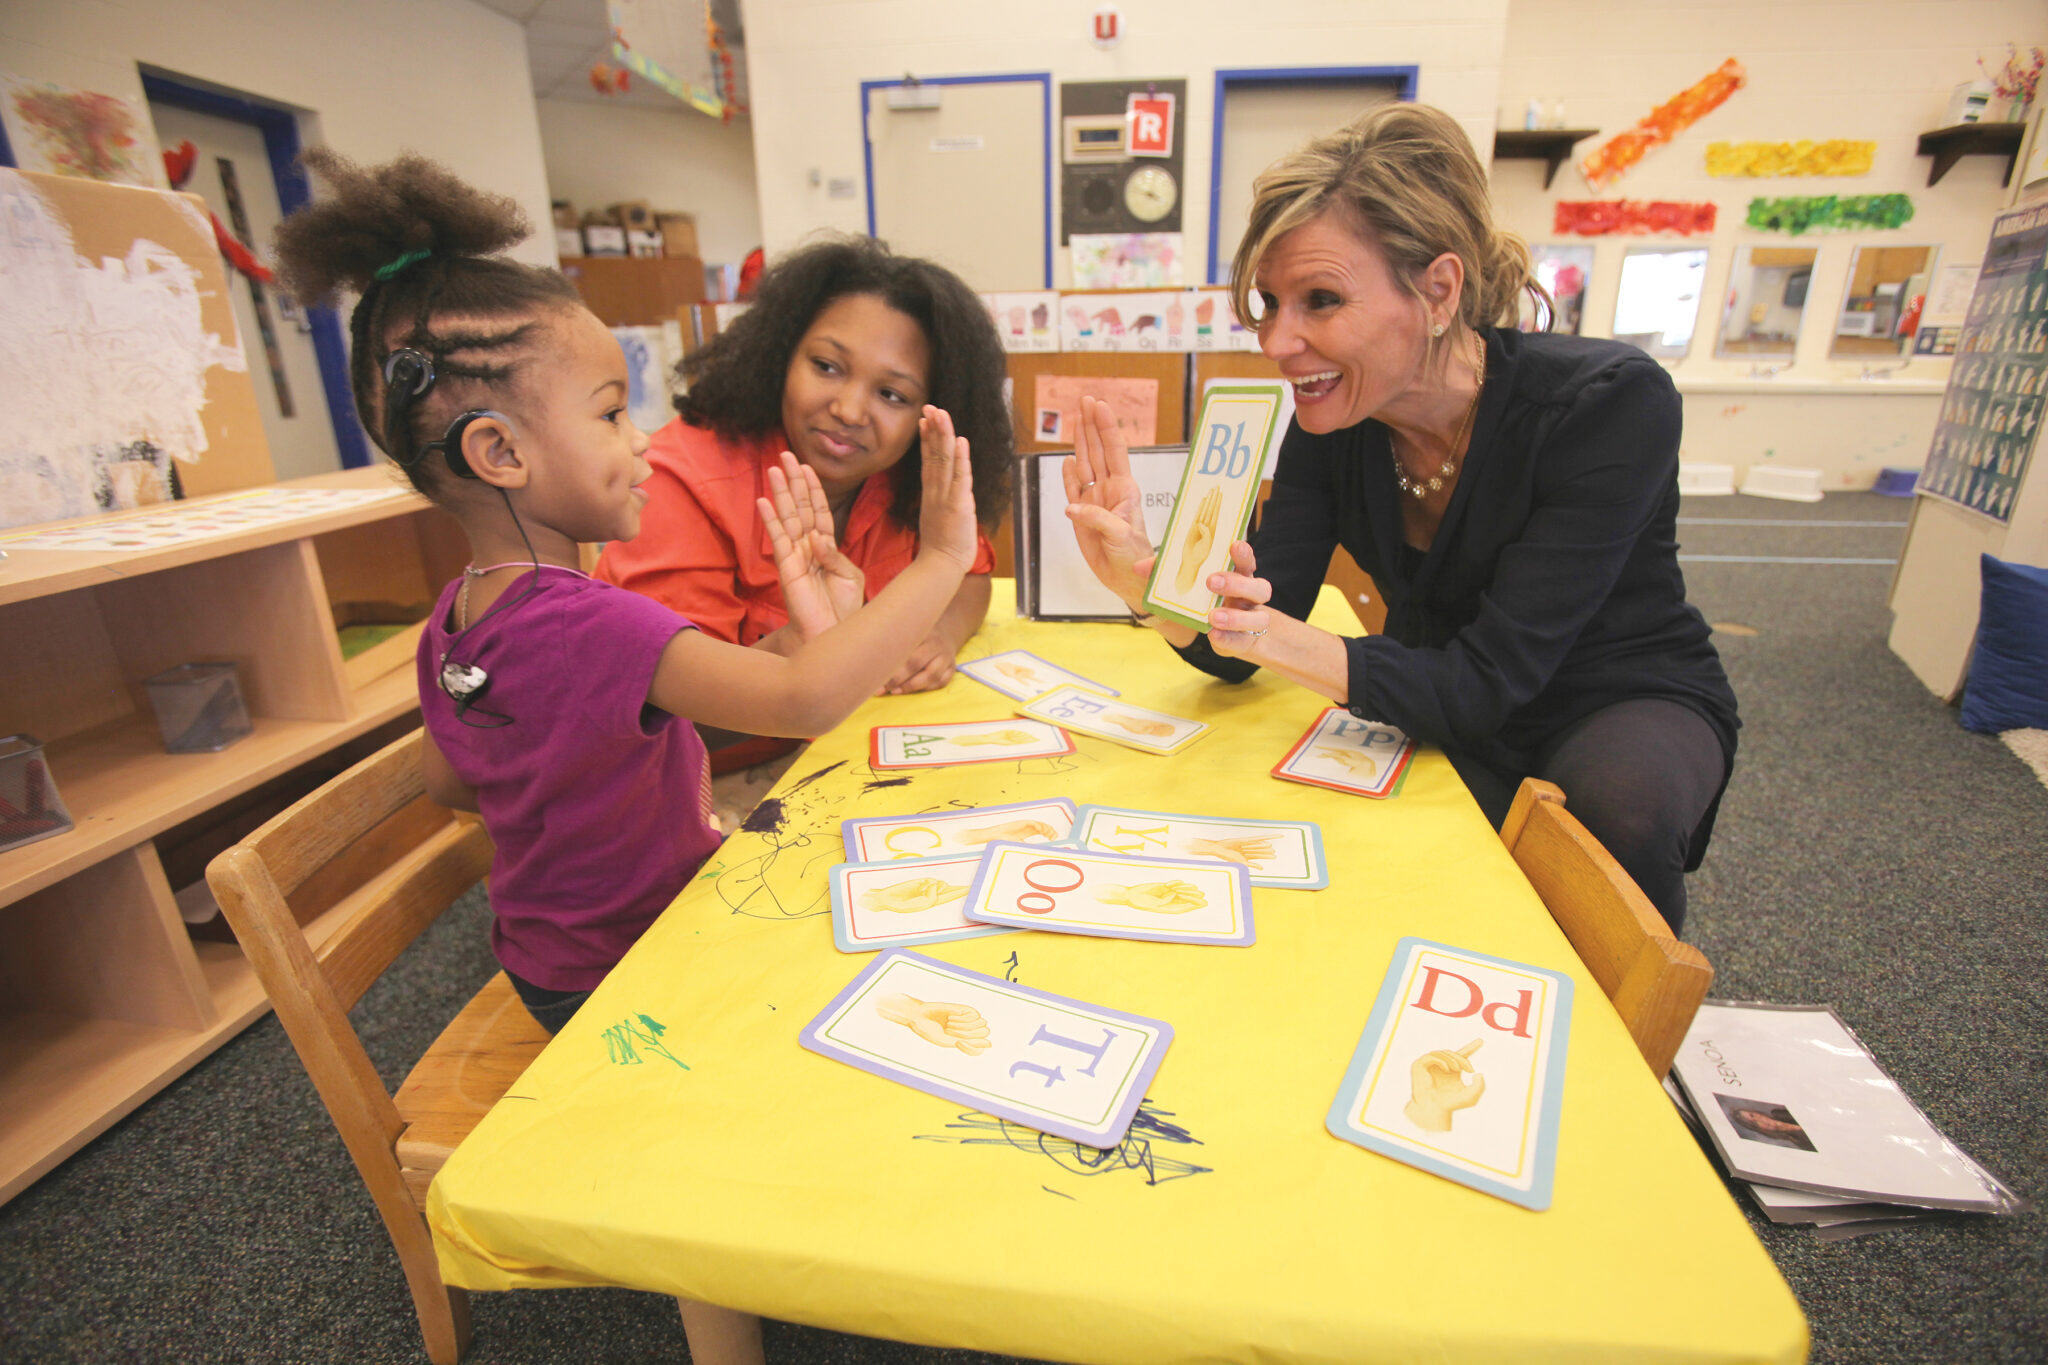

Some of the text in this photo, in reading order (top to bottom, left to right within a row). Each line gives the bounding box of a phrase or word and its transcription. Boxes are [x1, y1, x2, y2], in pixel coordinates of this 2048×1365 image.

[1138, 113, 1161, 142] R
[1197, 420, 1251, 479] Bb
[1049, 695, 1108, 718] Ee
[902, 732, 947, 759] Aa
[1328, 718, 1396, 748] Pp
[885, 826, 942, 860] C
[1016, 859, 1084, 915] Oo
[1410, 965, 1534, 1039] Dd
[1008, 1023, 1118, 1088] Tt
